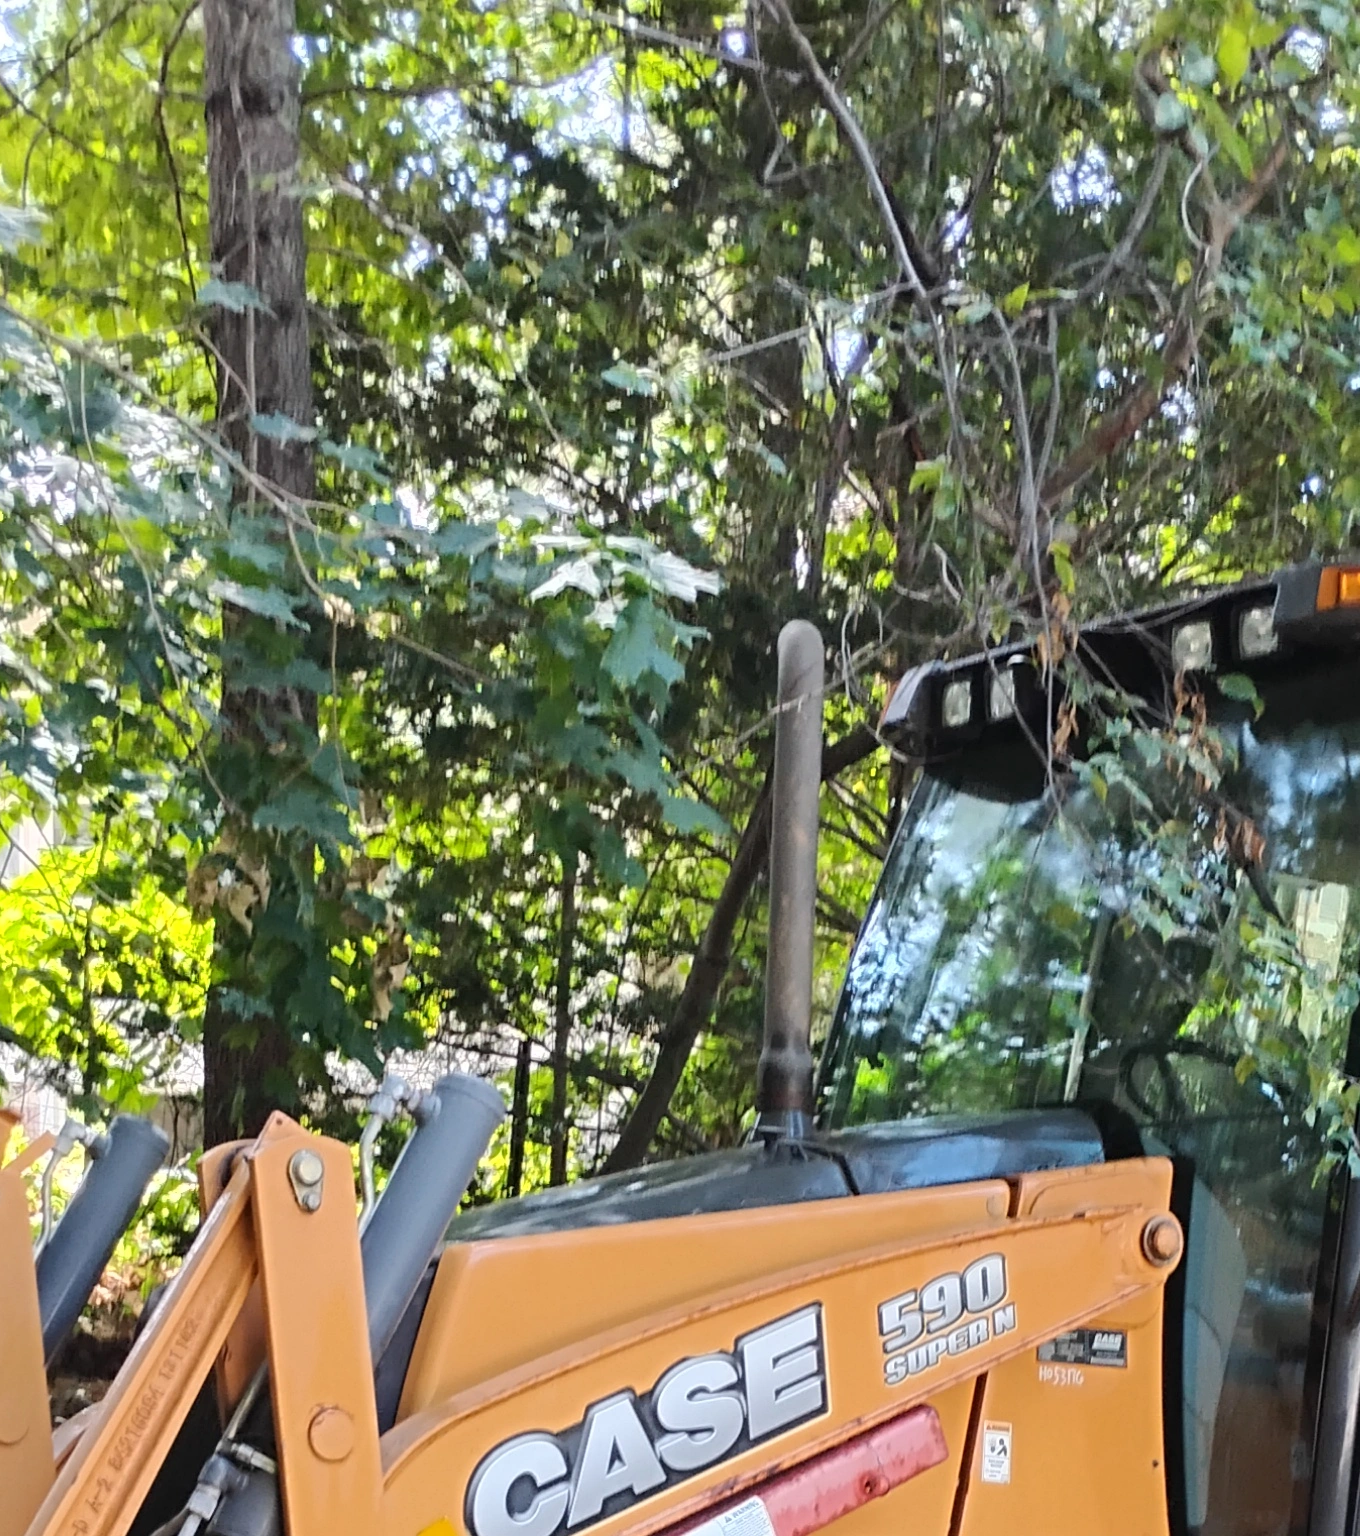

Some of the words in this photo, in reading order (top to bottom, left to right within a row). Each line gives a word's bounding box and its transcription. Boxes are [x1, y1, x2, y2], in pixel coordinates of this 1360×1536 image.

[878, 1252, 1006, 1354] 590
[884, 1317, 990, 1385] SUPER
[993, 1302, 1016, 1336] N
